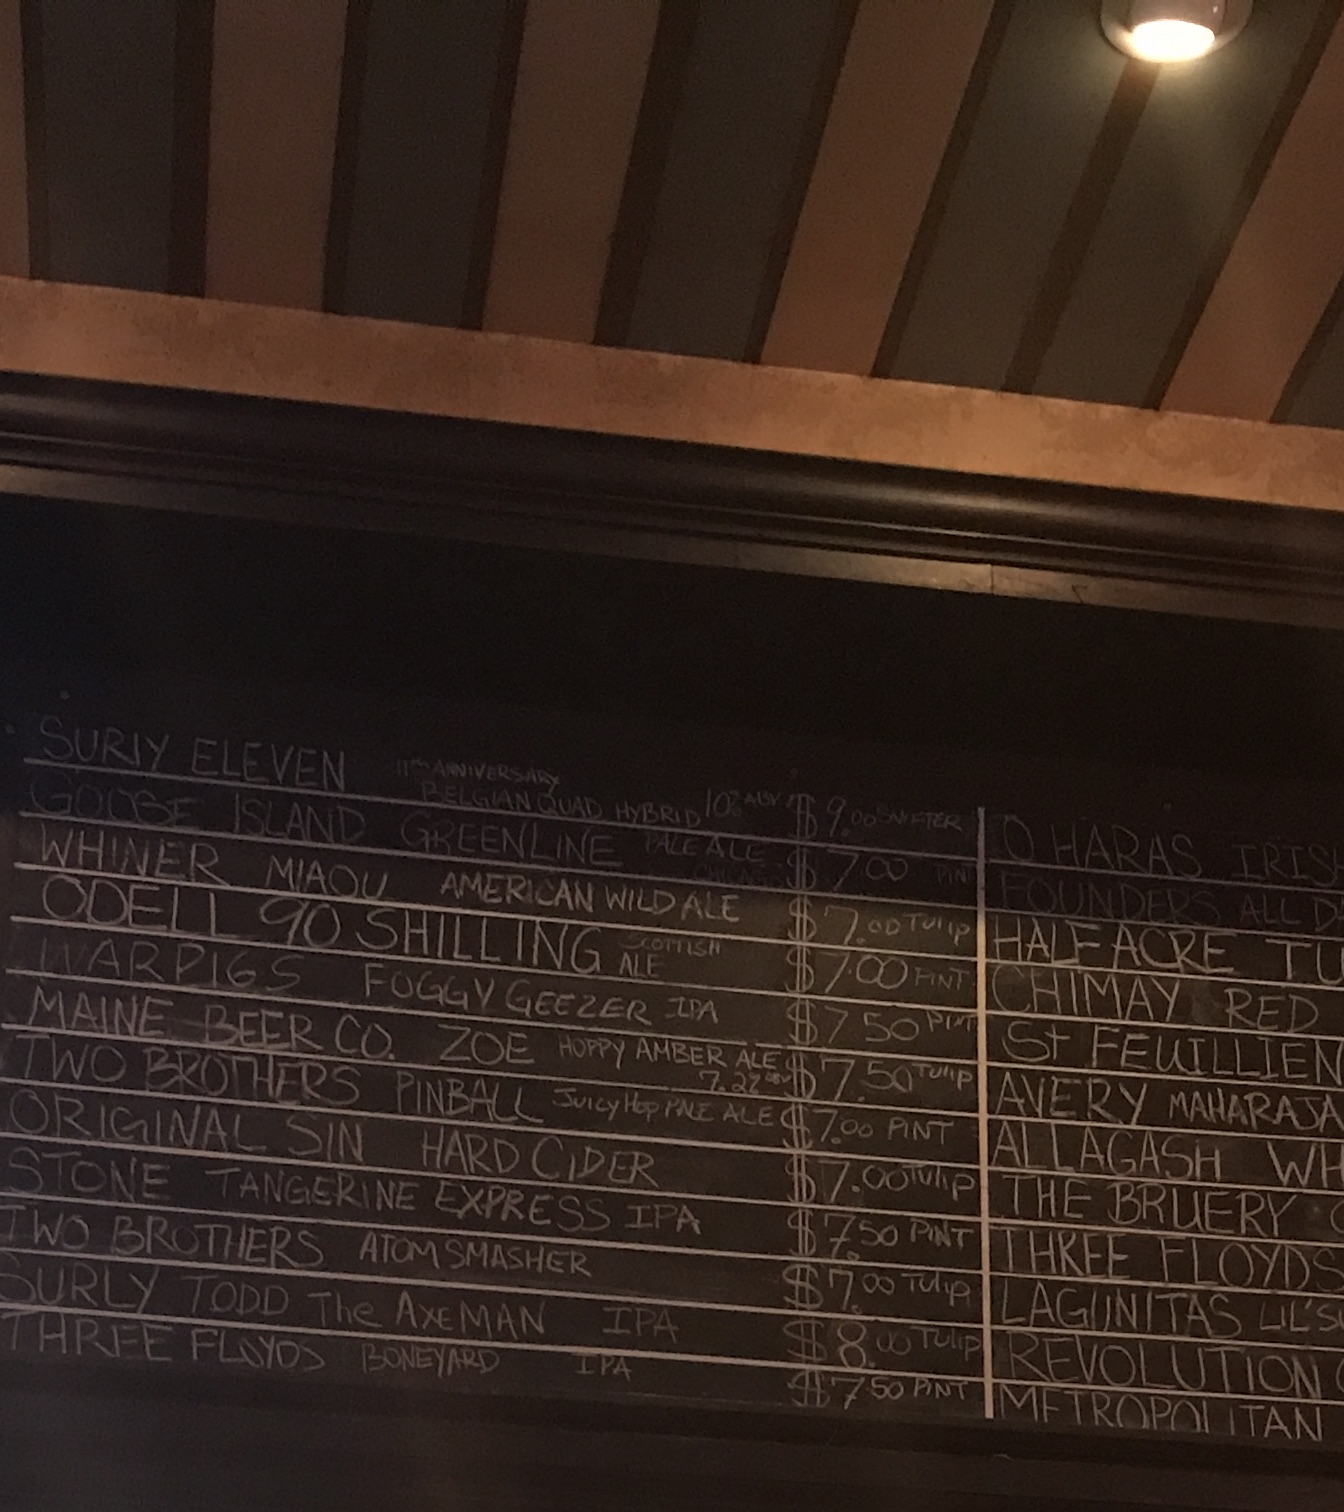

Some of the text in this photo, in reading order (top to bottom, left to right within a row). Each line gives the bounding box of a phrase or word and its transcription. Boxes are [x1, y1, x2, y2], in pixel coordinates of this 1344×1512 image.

[192, 738, 344, 791] ELEVEN
[235, 792, 364, 844] ISLAND
[645, 833, 697, 855] PALE
[706, 836, 764, 863] ALE
[422, 781, 700, 827] BELGIAN QUAD HYBRID
[41, 824, 230, 887] WHINER
[441, 872, 593, 913] AMERICAN
[606, 885, 676, 914] WILD
[680, 893, 740, 922] ALE
[43, 875, 601, 973] ODELL 90 SHILLING
[1241, 894, 1301, 924] ALL
[619, 953, 660, 977] ALE
[995, 917, 1102, 965] HALF
[1112, 923, 1239, 974] ACRE
[365, 963, 494, 1010] FOGGY
[507, 979, 651, 1024] GEEZER
[992, 965, 1180, 1022] CHIMAY
[1225, 988, 1319, 1032] RED
[28, 985, 174, 1037] MAINE
[205, 1005, 324, 1050] BEER
[438, 1024, 534, 1065] ZOE
[559, 1035, 625, 1070] HOPPY
[637, 1037, 726, 1066] AMBER
[736, 1050, 781, 1069] ALE
[16, 1035, 126, 1081] TWO
[144, 1046, 361, 1105] BROTHERS
[397, 1070, 543, 1123] PINBALL
[723, 1103, 773, 1127] ALE
[888, 1118, 953, 1145] PINT
[995, 1071, 1147, 1125] AVERY
[11, 1089, 266, 1152] ORIGINAL
[287, 1113, 363, 1165] SIN
[422, 1126, 519, 1175] HARD
[992, 1120, 1221, 1181] ALLAGASH
[9, 1146, 171, 1203] STONE
[206, 1167, 419, 1210] TANGERINE
[436, 1180, 611, 1232] EXPRESS
[625, 1203, 701, 1235] IPA
[1002, 1174, 1091, 1220] THE
[1108, 1181, 1297, 1237] BRUERY
[111, 1215, 323, 1268] BROTHERS
[359, 1232, 439, 1269] ATOM
[445, 1239, 591, 1277] SMASHER
[990, 1226, 1129, 1279] THREE
[181, 1274, 289, 1316] TODD
[604, 1306, 679, 1344] IPA
[1, 1311, 174, 1362] THREE
[362, 1343, 500, 1379] BONEYARD
[576, 1354, 631, 1381] IPA
[914, 1378, 968, 1400] PINT
[1005, 1331, 1321, 1399] REVOLUTION
[999, 1384, 1322, 1441] METROPOLITAN
